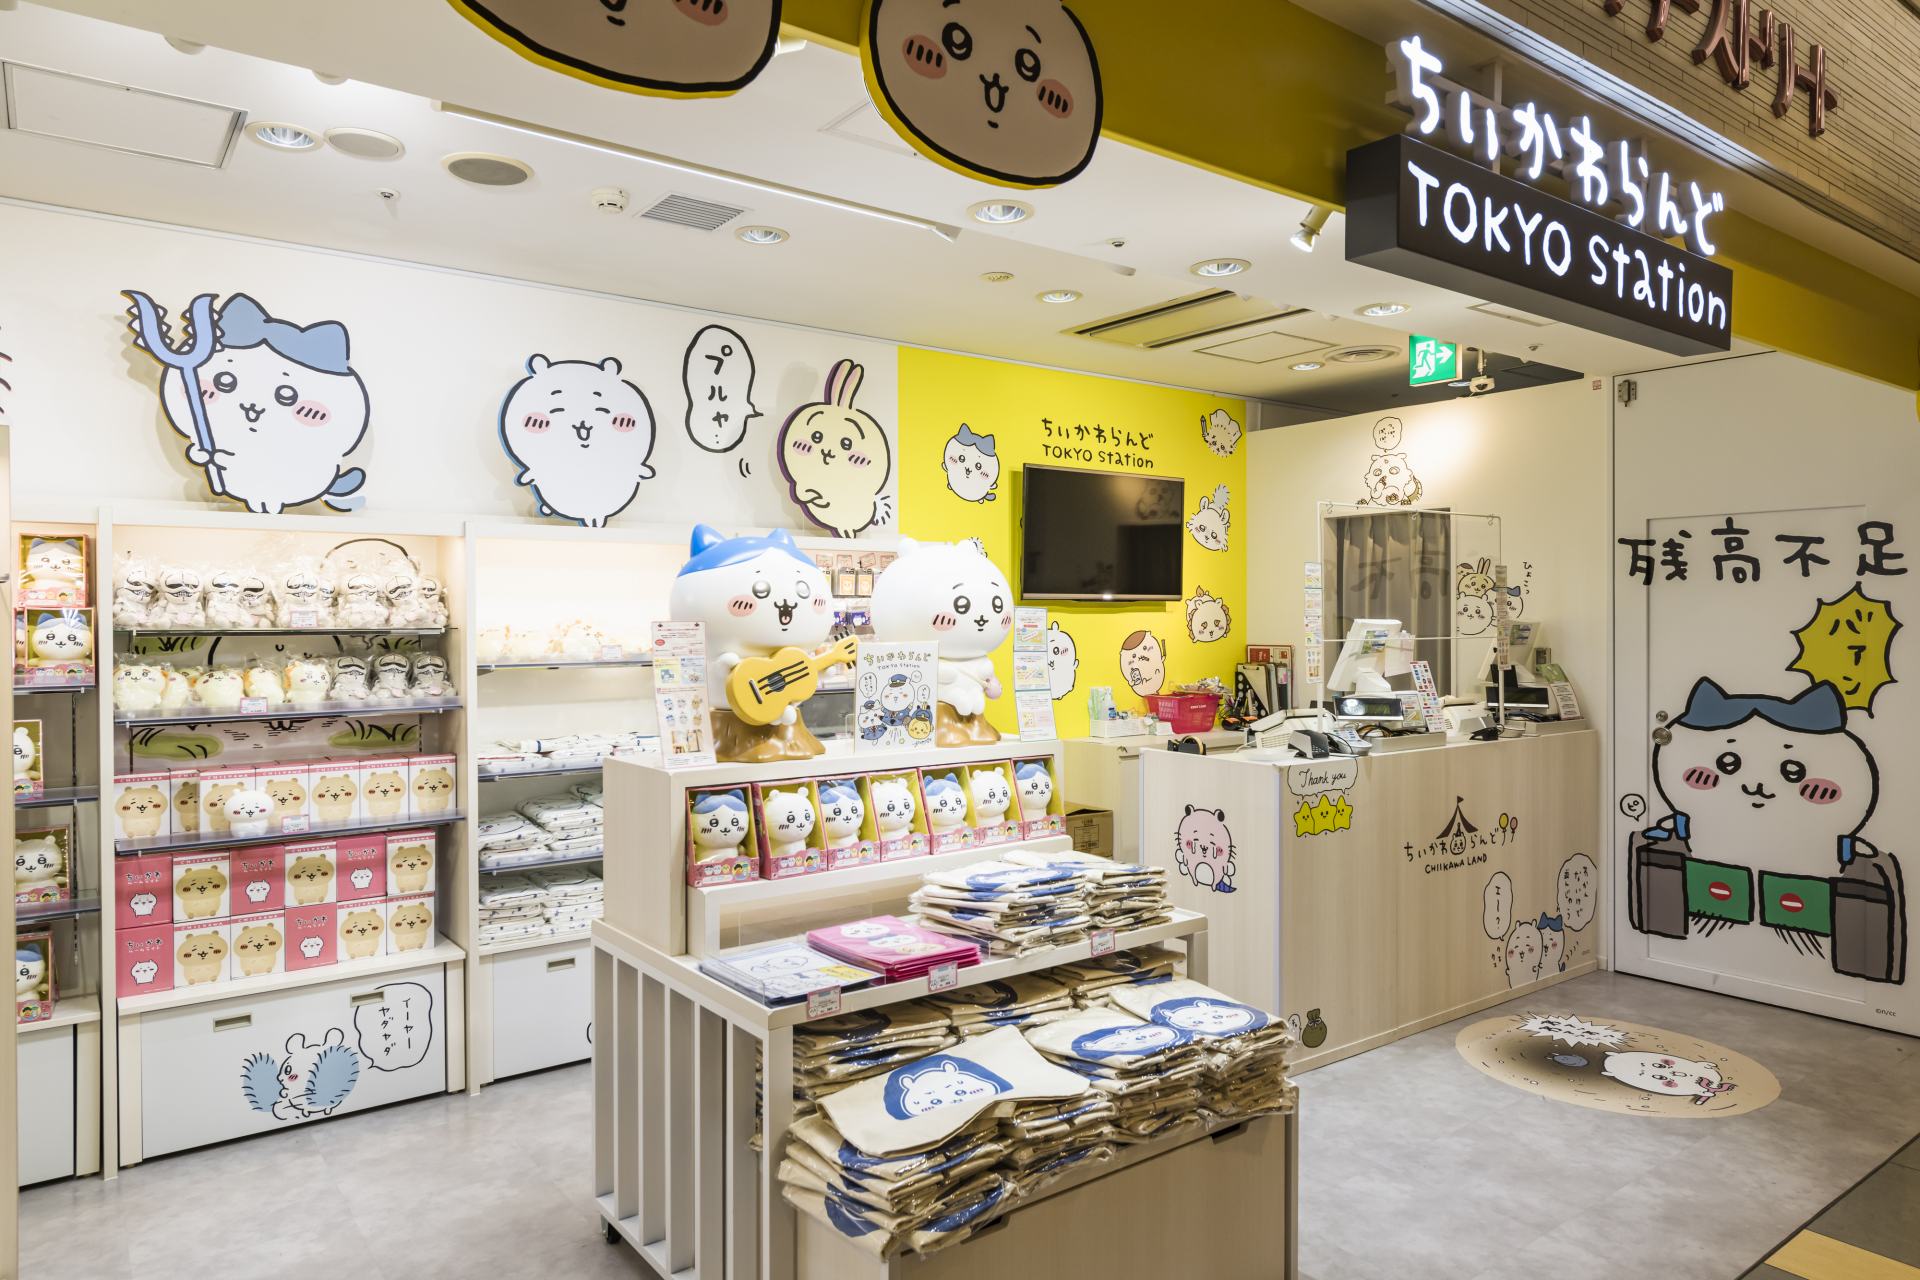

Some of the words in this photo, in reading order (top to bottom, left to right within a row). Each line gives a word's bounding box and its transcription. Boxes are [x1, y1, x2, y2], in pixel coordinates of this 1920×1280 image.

[1400, 35, 1724, 256] ちいかわらんど
[1407, 160, 1572, 277] TOKYO
[1588, 234, 1727, 330] Station
[1041, 417, 1154, 450] ちいかわらんど
[1042, 443, 1092, 462] TOKYO
[1098, 450, 1154, 469] Station
[1617, 516, 1908, 586] 残高不足
[1298, 767, 1329, 788] Thank
[1331, 772, 1347, 786] you
[1404, 828, 1499, 862] ちいかわらんど
[1425, 860, 1465, 874] CHIIKAWA
[1467, 853, 1488, 866] LAND
[378, 1006, 396, 1056] ヤダヤダ
